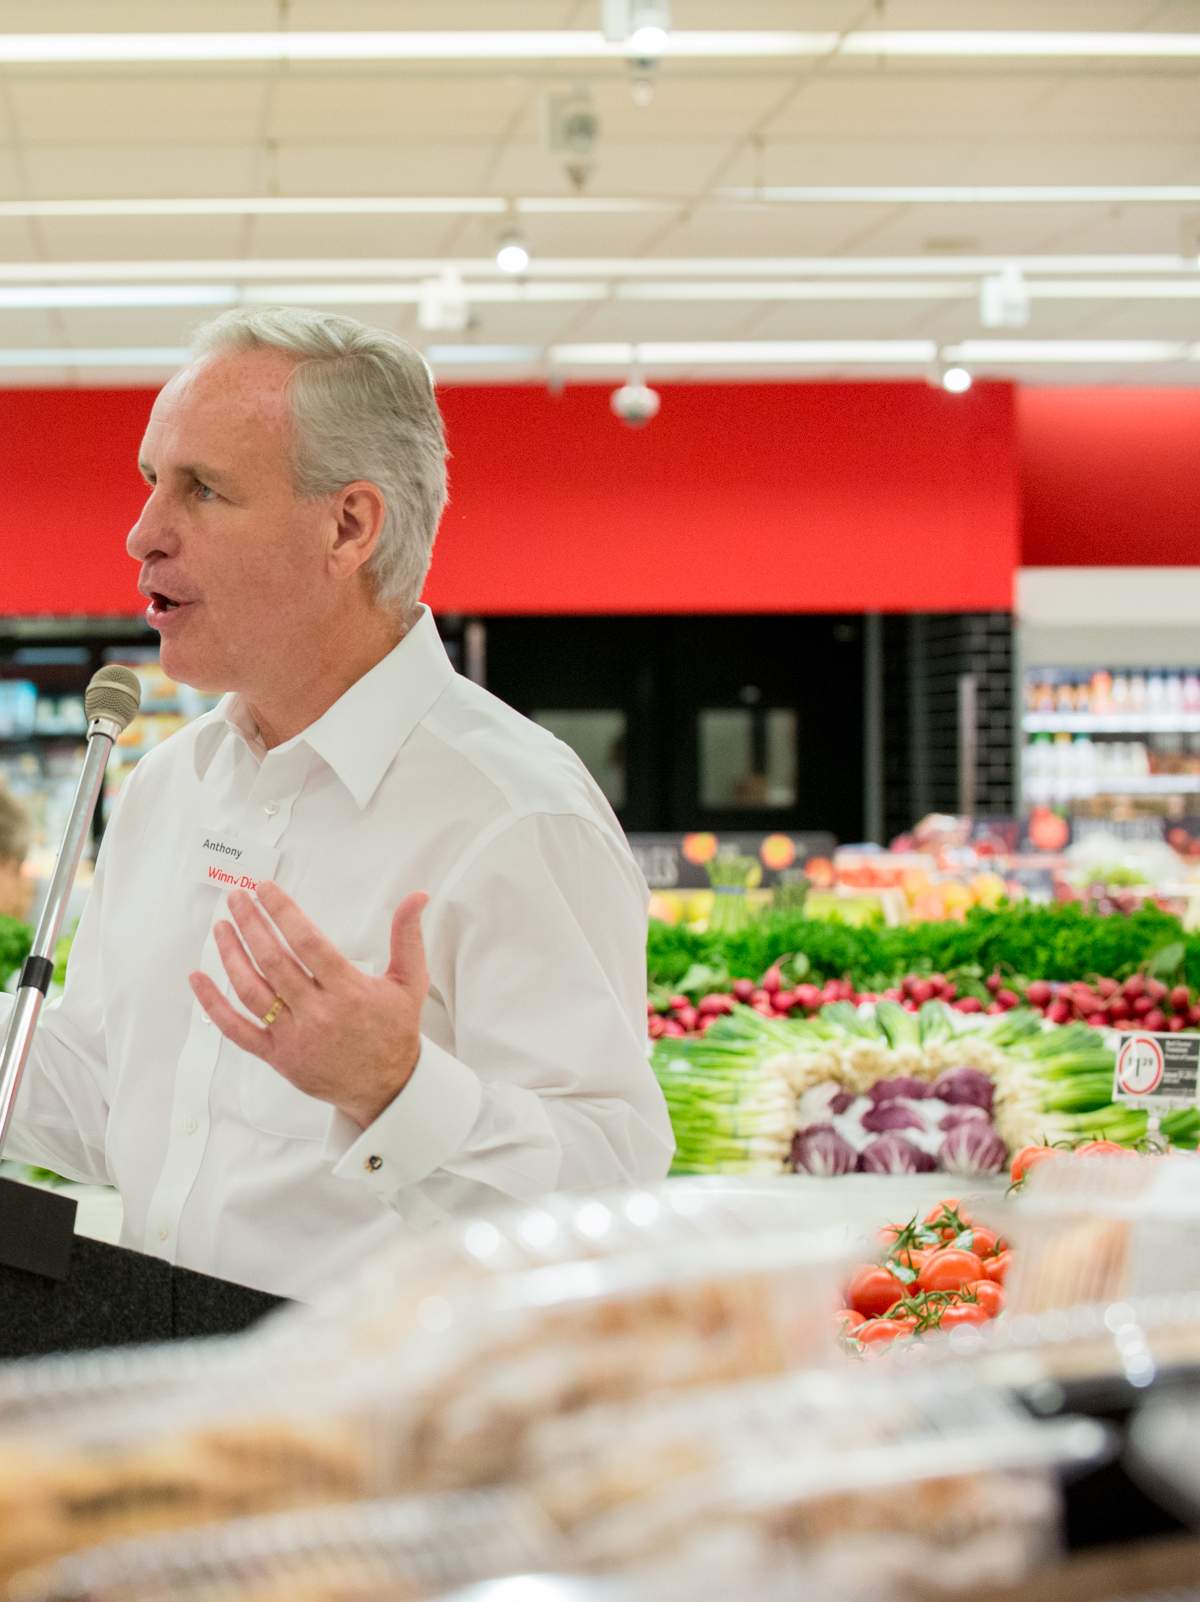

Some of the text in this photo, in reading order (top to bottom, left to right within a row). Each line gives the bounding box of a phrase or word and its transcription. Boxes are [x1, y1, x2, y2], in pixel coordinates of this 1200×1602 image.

[202, 839, 242, 860] Anthony
[207, 865, 257, 891] Winn Dix
